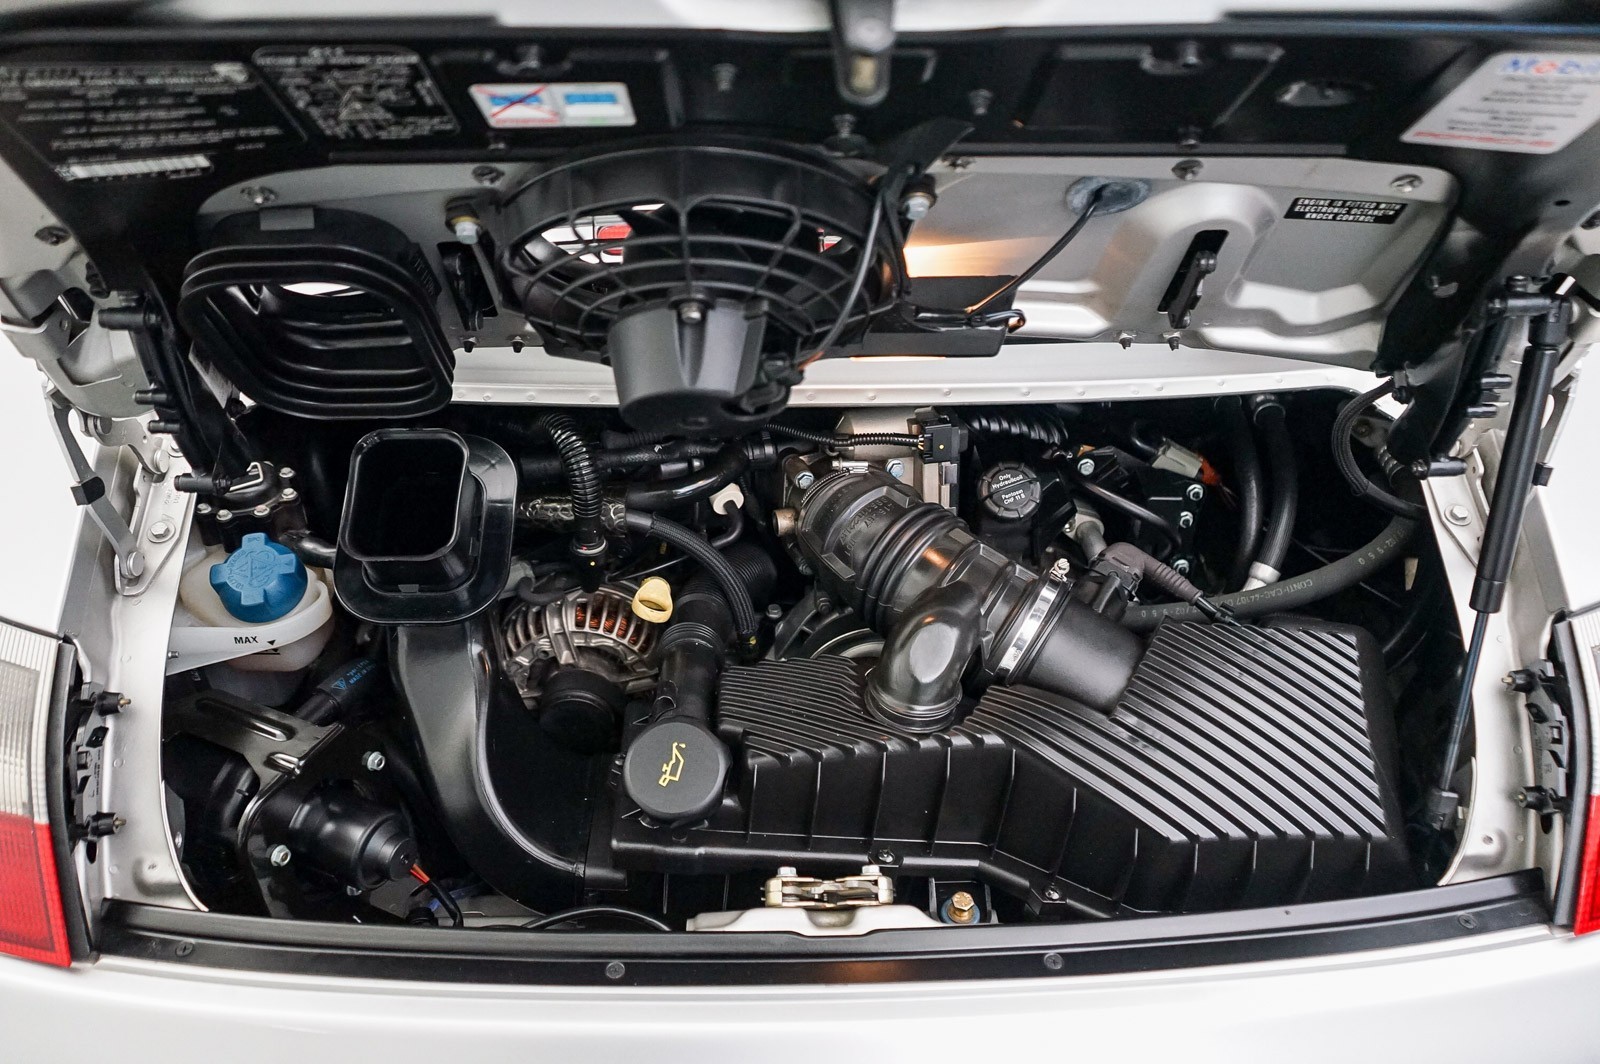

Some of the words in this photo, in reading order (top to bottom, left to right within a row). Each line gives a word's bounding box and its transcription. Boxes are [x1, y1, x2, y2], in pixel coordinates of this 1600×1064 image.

[1298, 198, 1331, 206] ENGINE
[1345, 200, 1377, 209] FITTED
[1294, 205, 1349, 214] ELECTRONIC
[1336, 214, 1376, 222] CONTROL
[233, 635, 259, 645] MAX
